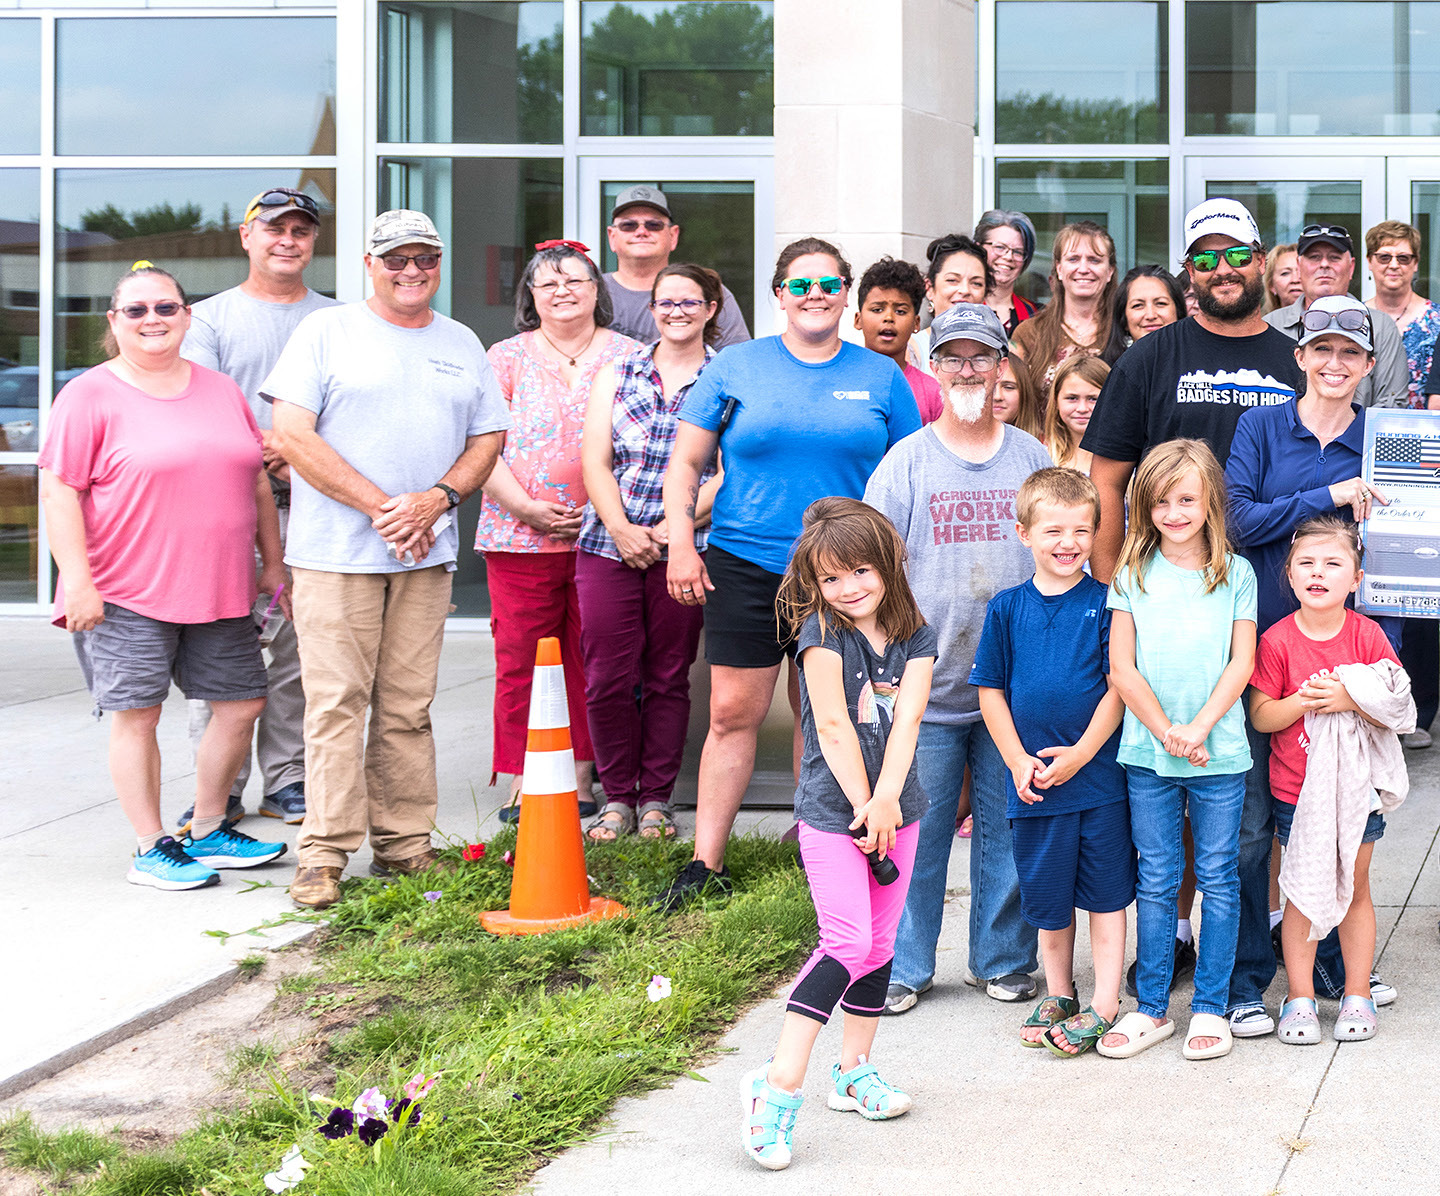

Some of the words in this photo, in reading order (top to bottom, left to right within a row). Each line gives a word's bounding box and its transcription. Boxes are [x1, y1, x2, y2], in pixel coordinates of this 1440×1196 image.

[1190, 212, 1241, 230] TaylorMade
[1177, 388, 1231, 405] BADGES
[1232, 389, 1258, 407] FOR
[1260, 391, 1294, 406] HOP
[929, 489, 1019, 504] AGRICULTUR
[933, 523, 1008, 546] HERE.
